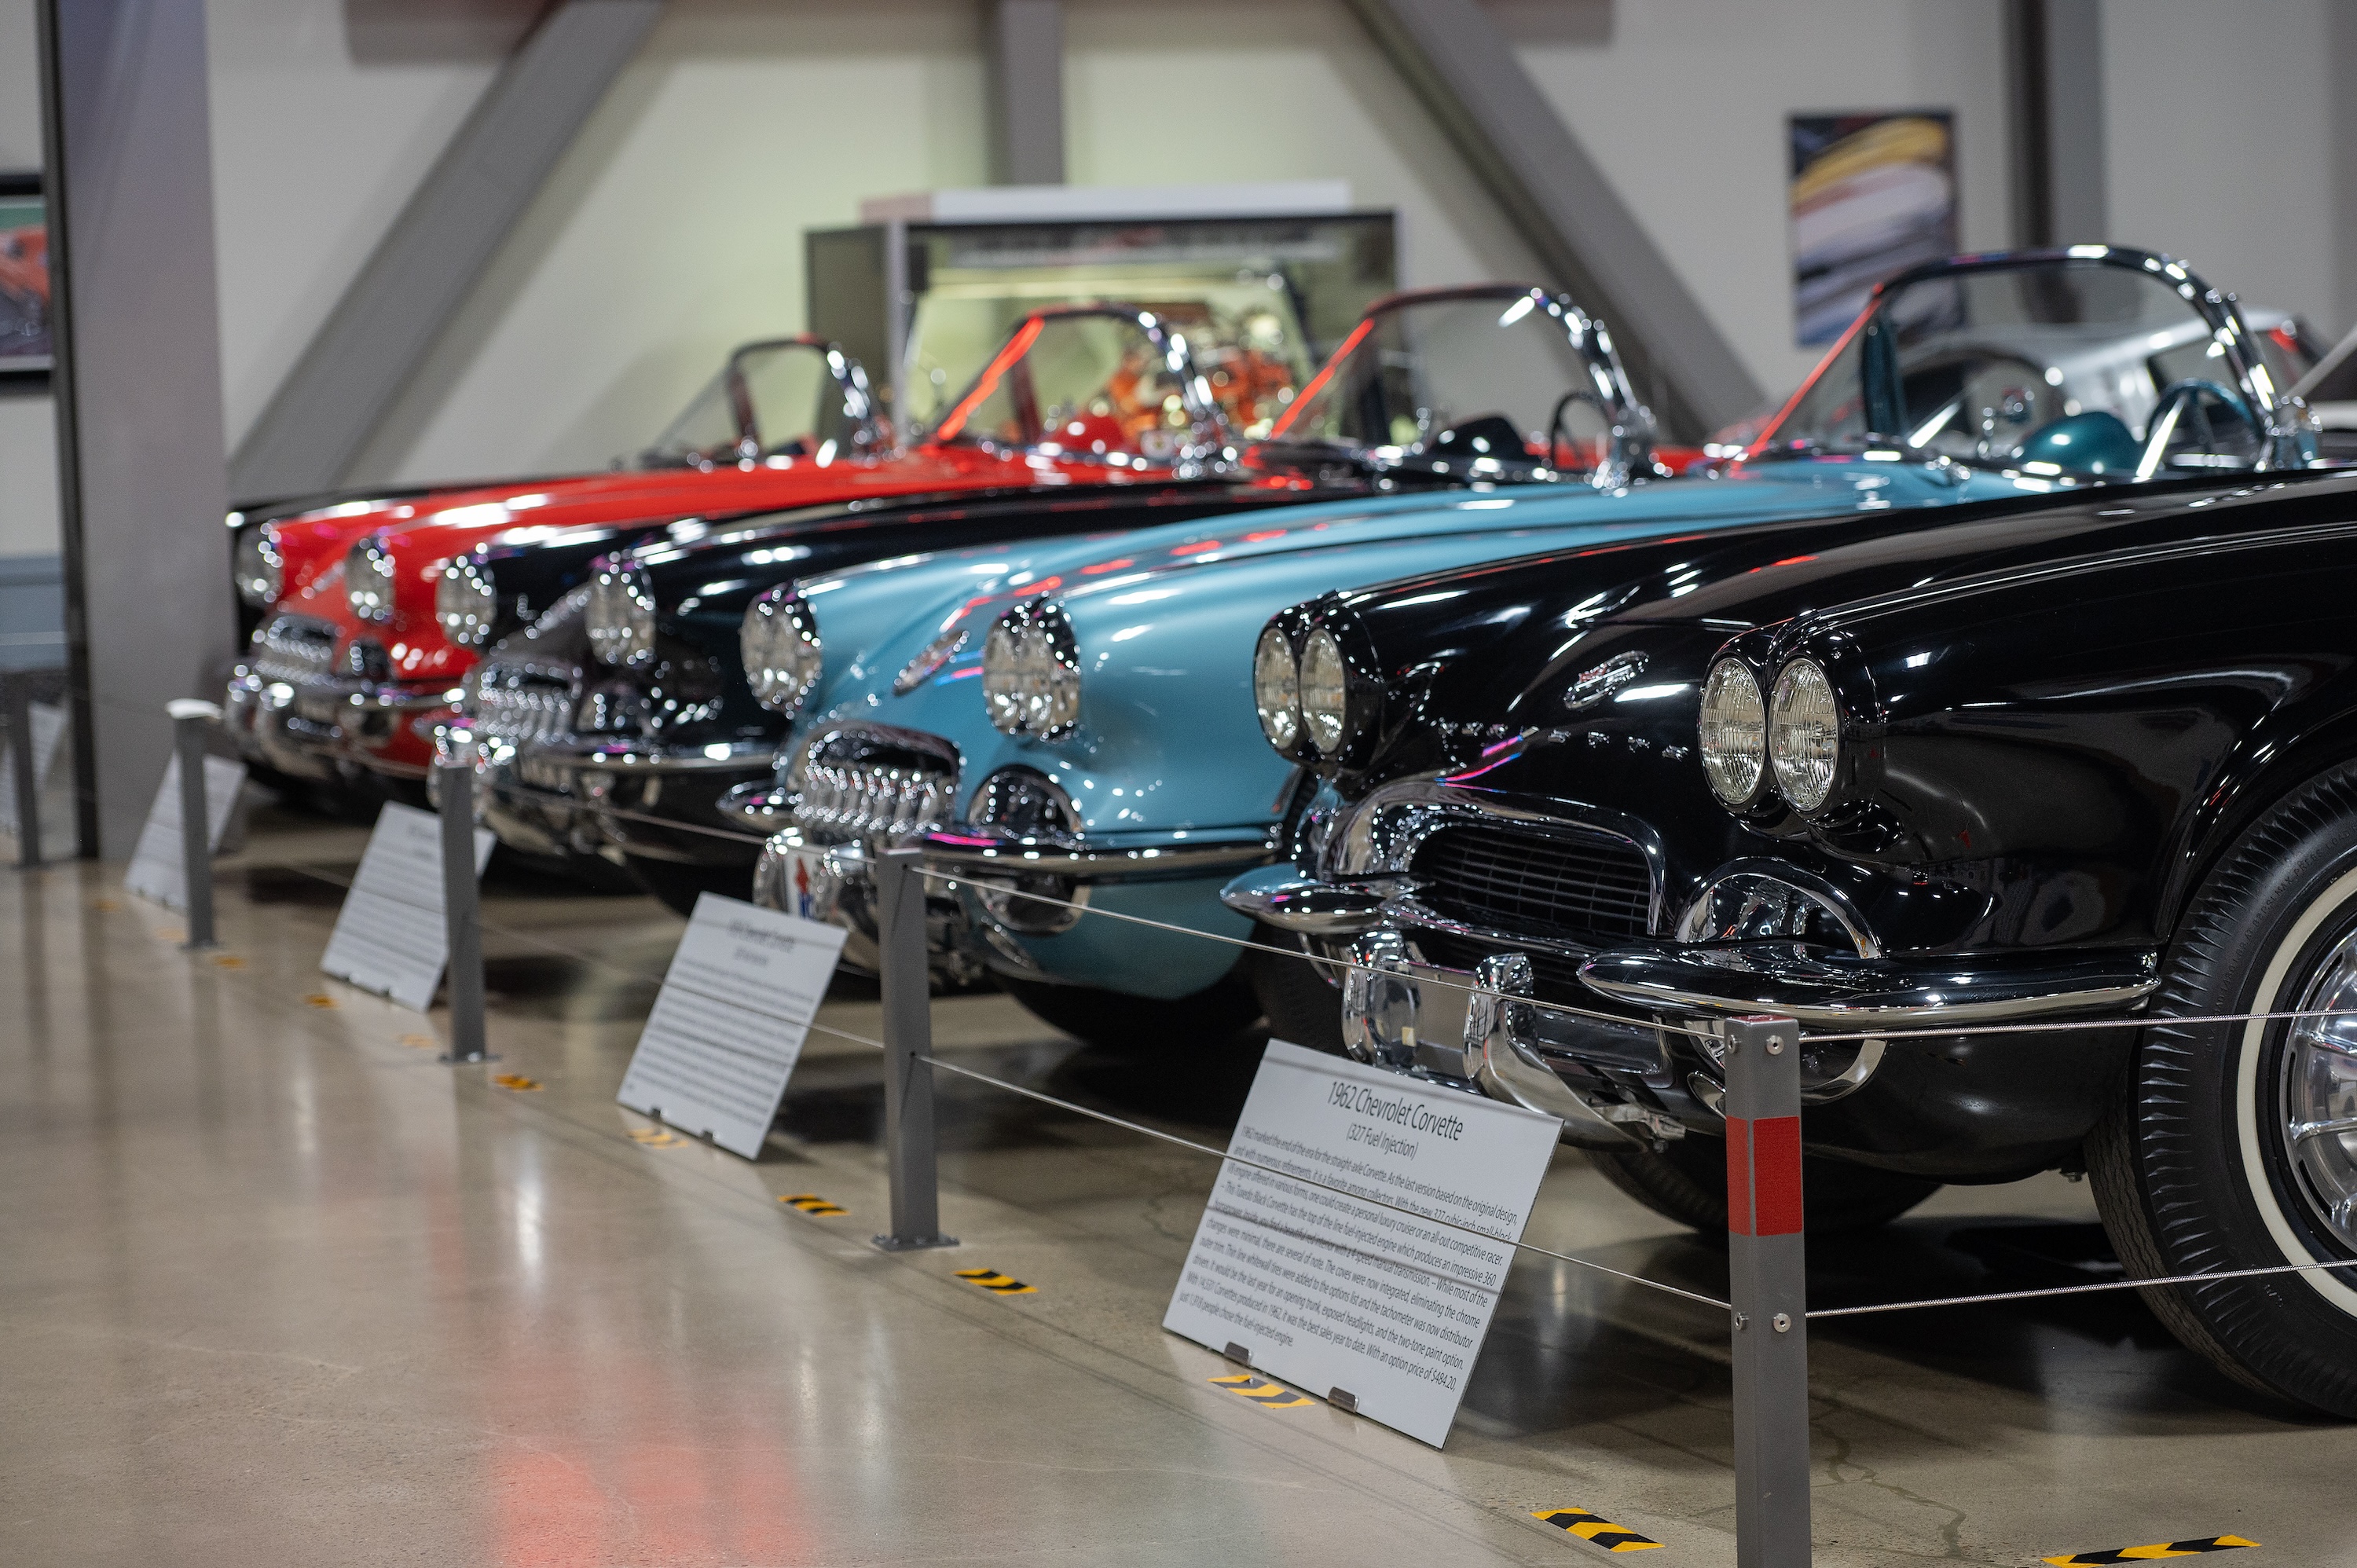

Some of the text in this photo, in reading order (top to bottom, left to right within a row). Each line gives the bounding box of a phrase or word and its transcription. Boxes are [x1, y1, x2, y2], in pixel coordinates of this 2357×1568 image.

[2273, 874, 2295, 897] MAX
[1329, 1079, 1463, 1141] 1962 Chevrolet Corvette
[1346, 1122, 1418, 1161] (327 Fuel Injection)
[1326, 1173, 1347, 1190] favorite
[1395, 1195, 1409, 1211] With
[1418, 1206, 1434, 1218] new
[1362, 1163, 1387, 1182] Corvette.
[1403, 1176, 1417, 1191] last
[1414, 1182, 1435, 1197] version
[1434, 1186, 1456, 1203] based
[1472, 1200, 1498, 1217] original
[1496, 1205, 1517, 1226] design,
[1266, 1195, 1288, 1213] Corvette
[1343, 1222, 1380, 1244] fuel-injected
[1377, 1236, 1397, 1251] engine
[1397, 1242, 1416, 1258] which
[1412, 1250, 1442, 1267] produces
[1450, 1259, 1483, 1281] impressive
[1483, 1271, 1497, 1286] 360
[1319, 1195, 1337, 1208] could
[1334, 1200, 1351, 1214] create
[1352, 1207, 1381, 1223] personal
[1377, 1212, 1398, 1233] luxury
[1396, 1221, 1416, 1236] cruiser
[1431, 1231, 1451, 1248] all-out
[1450, 1240, 1486, 1259] competitive
[1484, 1251, 1502, 1266] racer.
[1282, 1268, 1296, 1280] were
[1295, 1272, 1315, 1288] added
[1329, 1286, 1350, 1301] options
[1358, 1297, 1373, 1310] and
[1380, 1304, 1414, 1326] tachometer
[1424, 1323, 1442, 1335] now
[1440, 1325, 1473, 1349] distributor
[1285, 1247, 1307, 1262] several
[1335, 1266, 1351, 1280] coves
[1351, 1272, 1366, 1285] were
[1365, 1277, 1380, 1290] now
[1377, 1279, 1411, 1304] integrated,
[1410, 1292, 1444, 1318] eliminating
[1456, 1309, 1479, 1328] chrome
[1371, 1257, 1397, 1273] manual
[1393, 1263, 1431, 1287] transmission.
[1437, 1277, 1453, 1294] While
[1453, 1286, 1471, 1301] most
[1283, 1291, 1306, 1310] opening
[1305, 1297, 1321, 1315] trunk,
[1321, 1306, 1347, 1323] exposed
[1343, 1311, 1374, 1336] headlights,
[1375, 1327, 1390, 1339] and
[1398, 1334, 1426, 1354] two-tone
[1423, 1346, 1443, 1361] paint
[1442, 1353, 1464, 1370] option.
[1306, 1319, 1321, 1335] best
[1319, 1326, 1333, 1340] sales
[1331, 1332, 1346, 1345] year
[1351, 1337, 1366, 1354] date.
[1366, 1343, 1381, 1360] With
[1388, 1355, 1409, 1371] option
[1406, 1361, 1424, 1377] price
[1431, 1369, 1457, 1393] $484.20,
